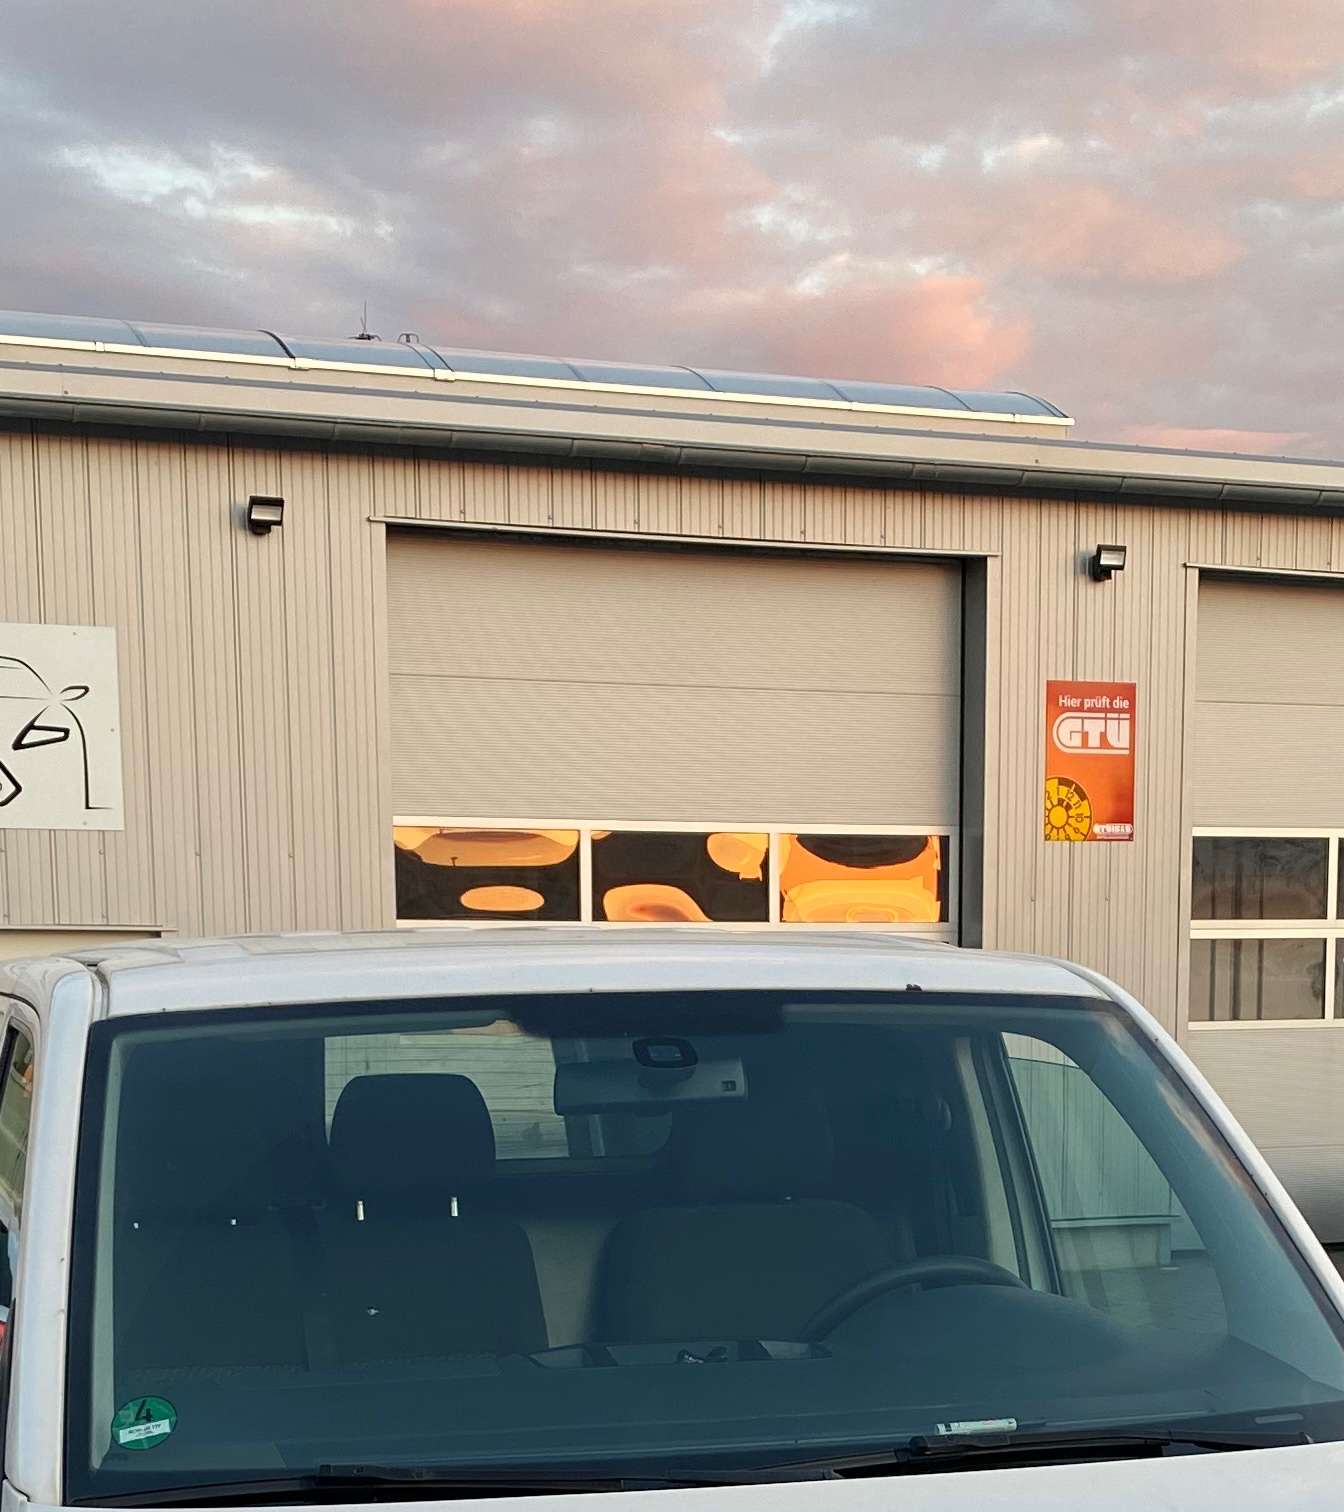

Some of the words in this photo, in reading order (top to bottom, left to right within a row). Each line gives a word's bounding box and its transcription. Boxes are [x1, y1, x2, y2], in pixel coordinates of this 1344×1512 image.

[1058, 695, 1082, 709] Hier
[1084, 695, 1111, 711] prüft
[1112, 696, 1130, 709] die
[1053, 712, 1131, 755] GTÜ
